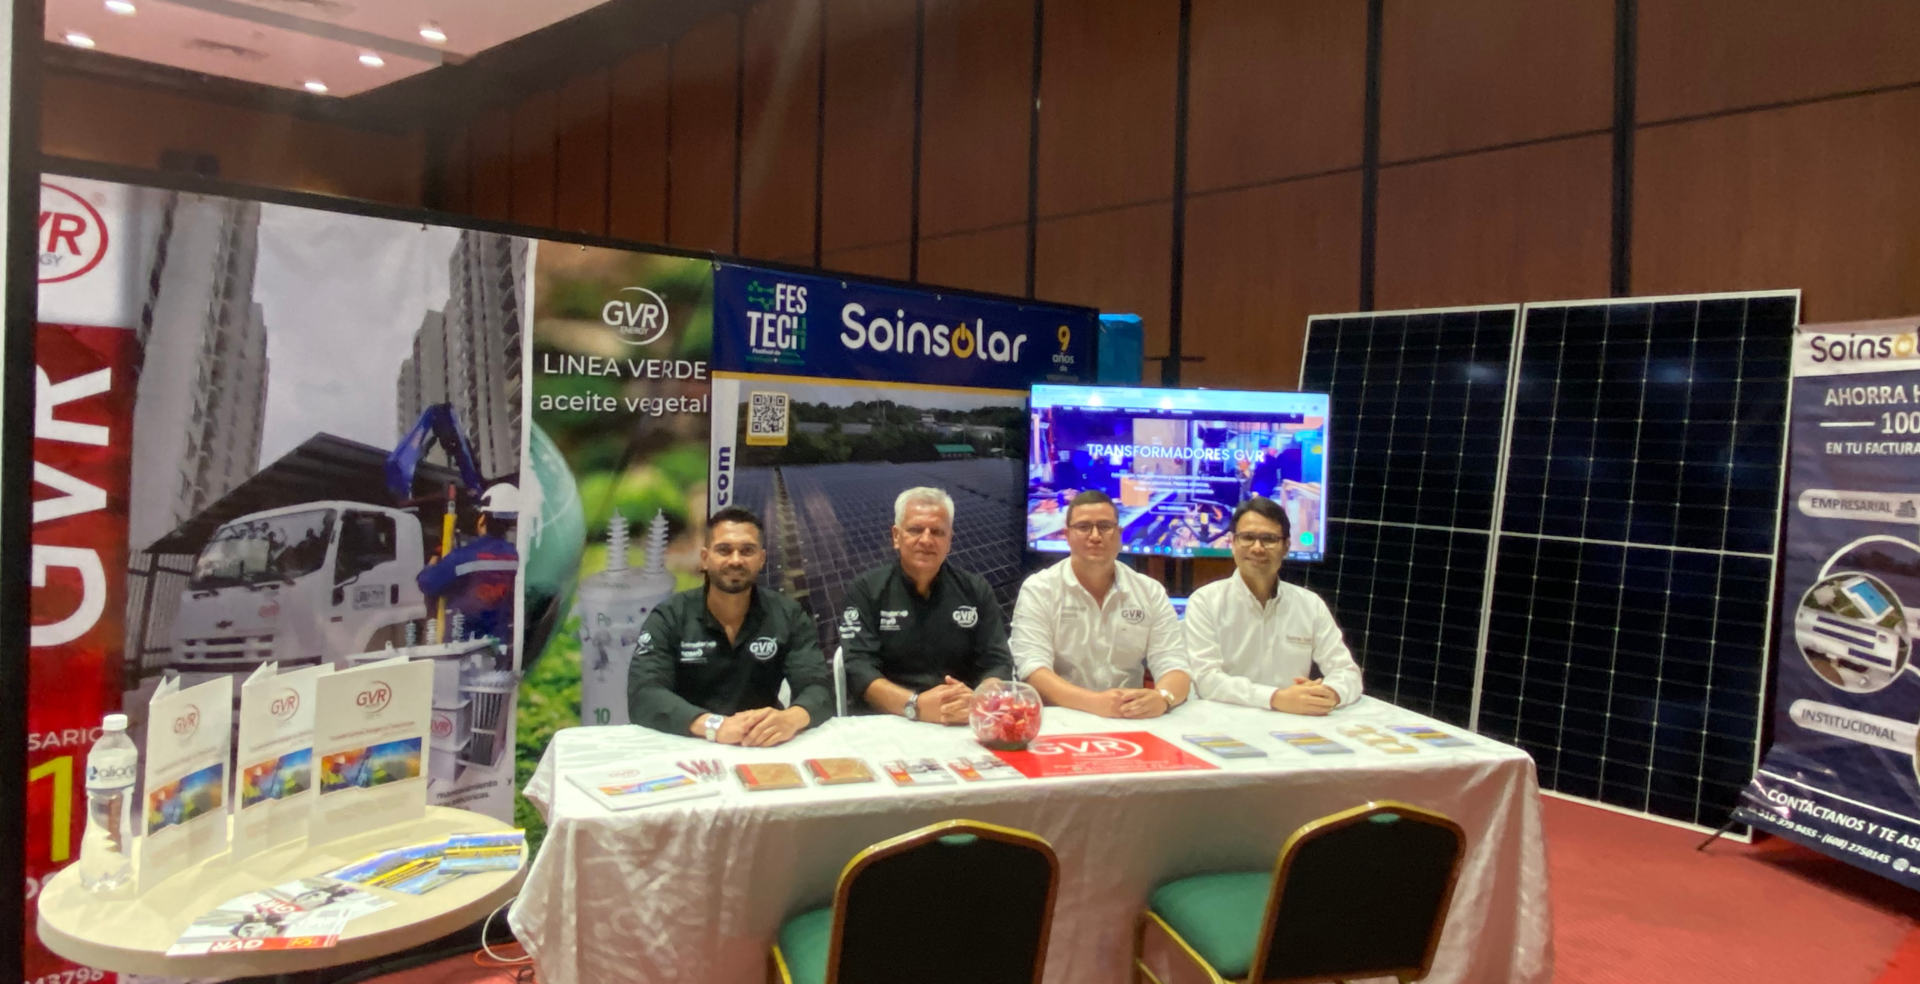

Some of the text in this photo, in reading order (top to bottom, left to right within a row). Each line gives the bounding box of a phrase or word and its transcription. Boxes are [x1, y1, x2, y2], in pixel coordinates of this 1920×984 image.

[776, 283, 807, 314] FES
[602, 300, 660, 329] GVR
[620, 326, 650, 335] ENERGY
[747, 311, 806, 350] TECH
[840, 302, 1027, 363] Soinsolar
[1058, 325, 1070, 351] 9
[544, 353, 707, 380] LINEA VERDE
[1052, 352, 1075, 364] años
[540, 390, 707, 417] aceite vegetal
[1825, 385, 1908, 407] AHORRA
[1087, 443, 1264, 463] TRANSFORMADORES GVR
[1826, 442, 1843, 455] EN
[1845, 441, 1863, 455] TU
[1811, 497, 1892, 514] EMPRESARIAL
[952, 610, 976, 621] GVR
[1121, 609, 1142, 619] GVR
[750, 642, 774, 653] GVR
[271, 695, 296, 716] GVR
[356, 689, 387, 706] GVR
[173, 712, 196, 735] GVR
[594, 707, 611, 725] 10
[1802, 708, 1897, 742] INSTITUCIONAL
[1028, 740, 1128, 755] GVR
[1767, 789, 1866, 832] CONTÁCTANOS
[1867, 822, 1878, 835] Y
[1878, 826, 1898, 842] TE
[213, 939, 264, 950] GVR
